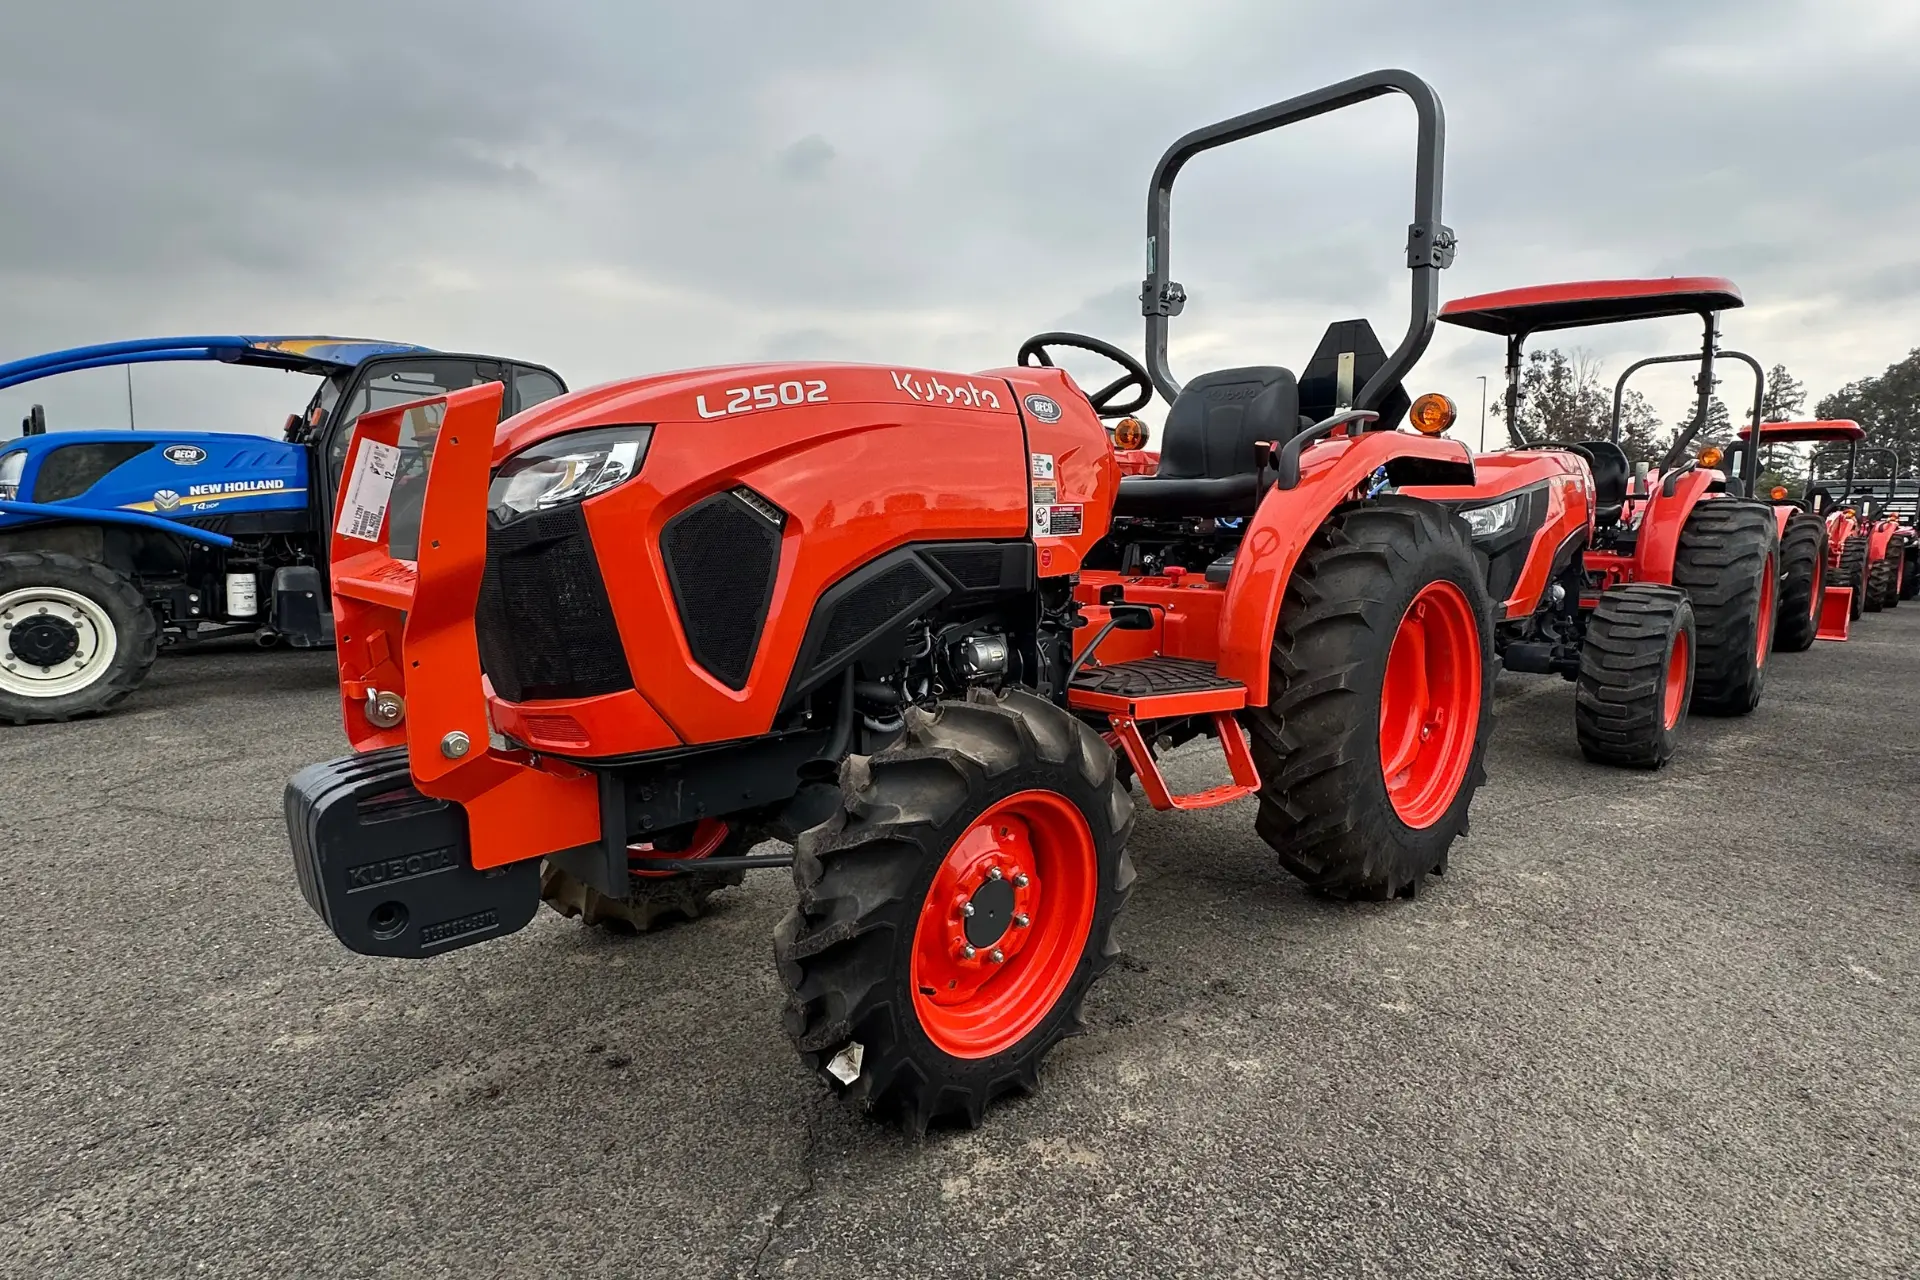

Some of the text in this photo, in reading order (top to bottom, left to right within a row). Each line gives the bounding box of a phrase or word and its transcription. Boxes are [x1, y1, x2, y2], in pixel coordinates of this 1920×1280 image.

[696, 380, 829, 419] L2502
[890, 370, 1000, 409] Kubota
[1034, 400, 1053, 413] BECO
[173, 450, 197, 459] BECO
[189, 479, 284, 496] NEW HOLLAND
[349, 849, 450, 885] KUBOTA
